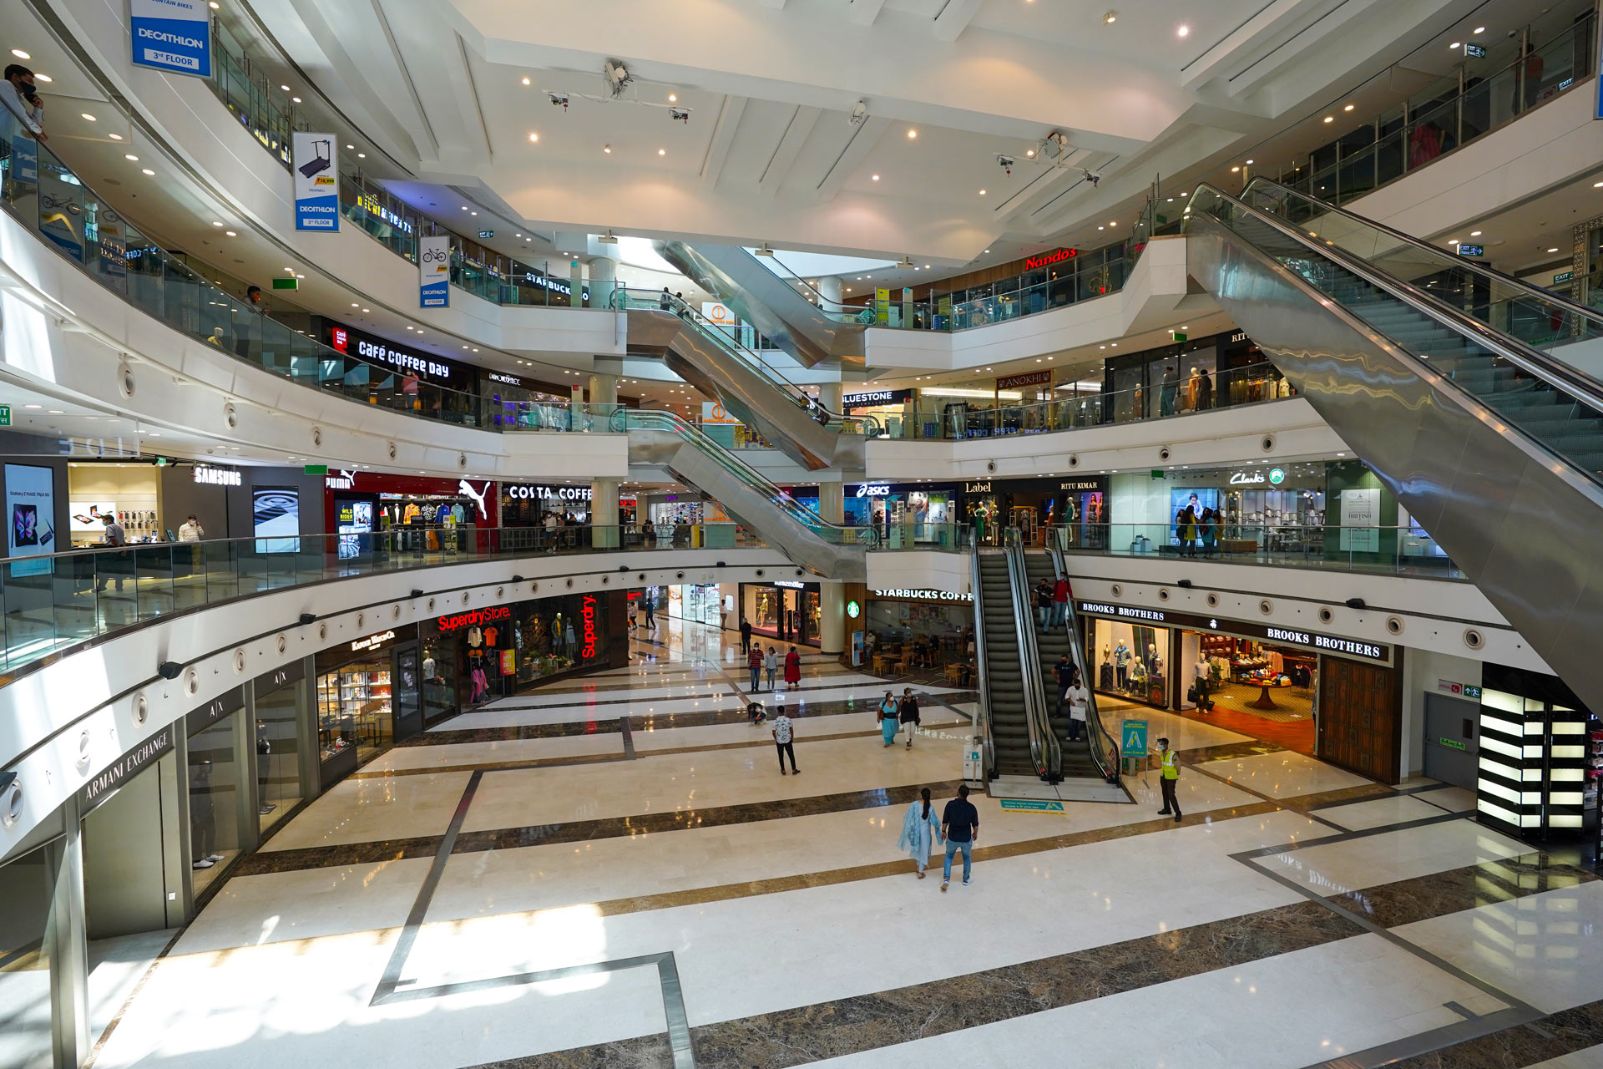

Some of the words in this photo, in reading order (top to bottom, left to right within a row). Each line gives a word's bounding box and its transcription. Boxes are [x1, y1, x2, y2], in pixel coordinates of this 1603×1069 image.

[138, 27, 204, 49] DECATHLON
[165, 54, 193, 66] FLOOR
[299, 205, 336, 214] DECATHLON
[1554, 272, 1569, 281] EXIT
[1231, 333, 1250, 342] RIT
[194, 467, 241, 486] SAMSUNG
[326, 477, 351, 489] PUMA
[965, 482, 991, 493] Label
[1061, 482, 1076, 490] RITU
[509, 485, 553, 499] COSTA
[558, 487, 592, 500] COFFE
[875, 589, 938, 599] STARBUCKS
[940, 591, 975, 601] COFFE
[1082, 603, 1116, 615] BROOKS
[1118, 607, 1165, 621] BROTHERS
[1267, 628, 1310, 644] BROOKS
[1315, 636, 1380, 657] BROTHERS
[85, 762, 125, 803] ARMANI
[126, 731, 169, 773] EXCHANGE
